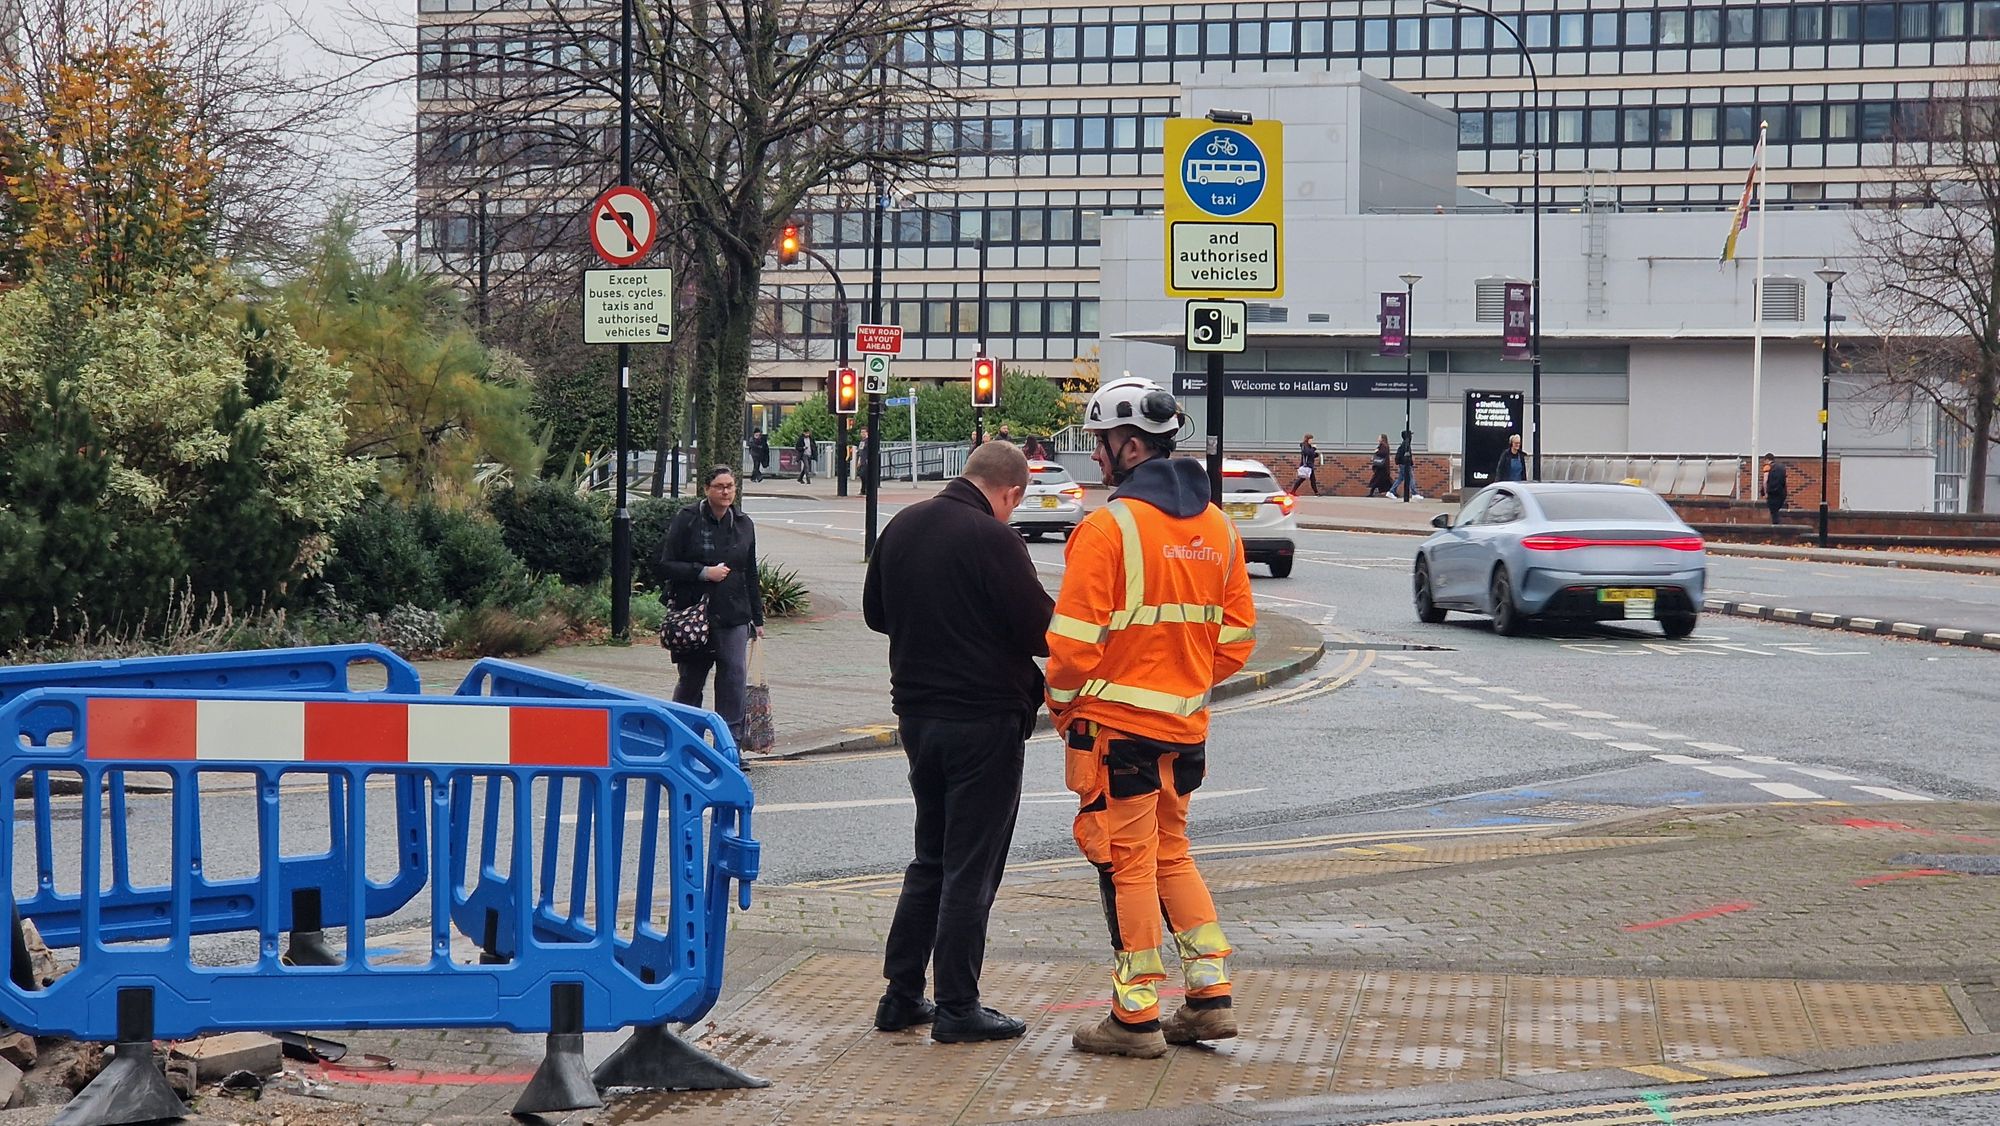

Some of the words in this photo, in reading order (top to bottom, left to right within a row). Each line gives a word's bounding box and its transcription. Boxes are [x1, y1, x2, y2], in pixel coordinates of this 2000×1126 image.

[1211, 193, 1236, 205] taxi
[1209, 231, 1239, 245] and
[1180, 249, 1268, 263] authorised
[1191, 267, 1258, 281] vehicles
[609, 275, 648, 286] Except
[602, 301, 629, 311] taxis
[633, 301, 654, 310] and
[597, 313, 658, 324] authorised
[605, 327, 651, 337] vehicles
[858, 327, 876, 335] NEW
[878, 328, 900, 336] ROAD
[863, 335, 894, 343] LAYOUT
[865, 342, 892, 350] AHEAD
[1230, 380, 1277, 390] Welcome
[1278, 380, 1291, 390] to
[1293, 381, 1331, 391] Hallam
[1333, 382, 1348, 391] SU
[1560, 642, 1871, 656] GATE
